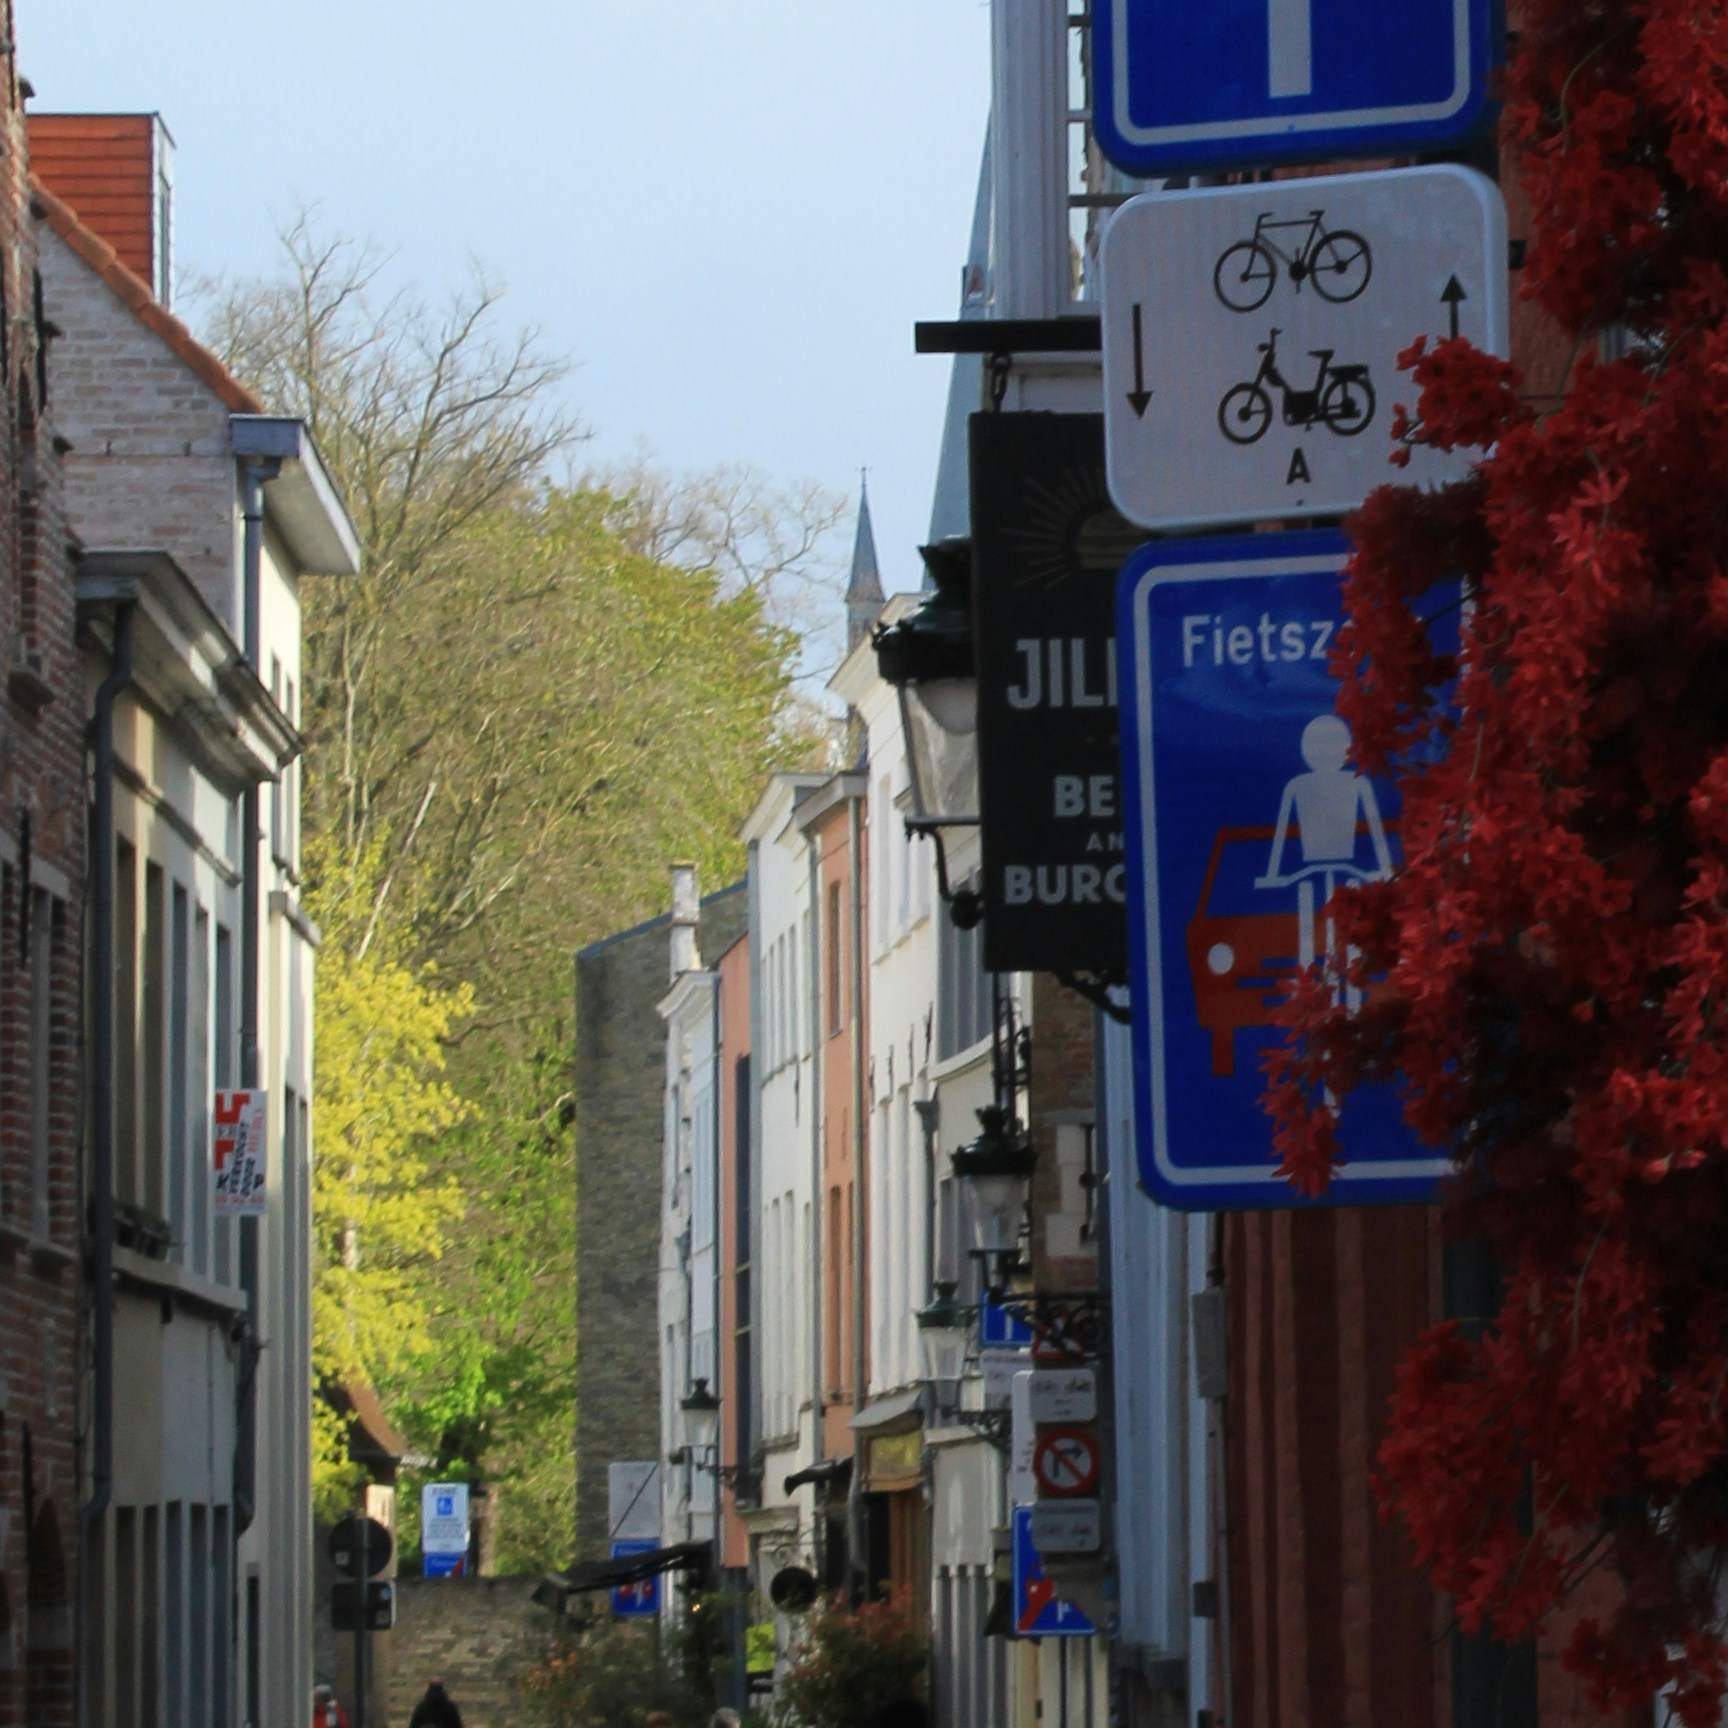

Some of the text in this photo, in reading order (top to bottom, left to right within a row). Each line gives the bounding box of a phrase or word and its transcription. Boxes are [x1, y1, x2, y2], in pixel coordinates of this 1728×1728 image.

[1285, 447, 1311, 485] A
[1182, 612, 1344, 668] Fietsz
[1053, 773, 1116, 818] BE
[1085, 831, 1125, 852] AN
